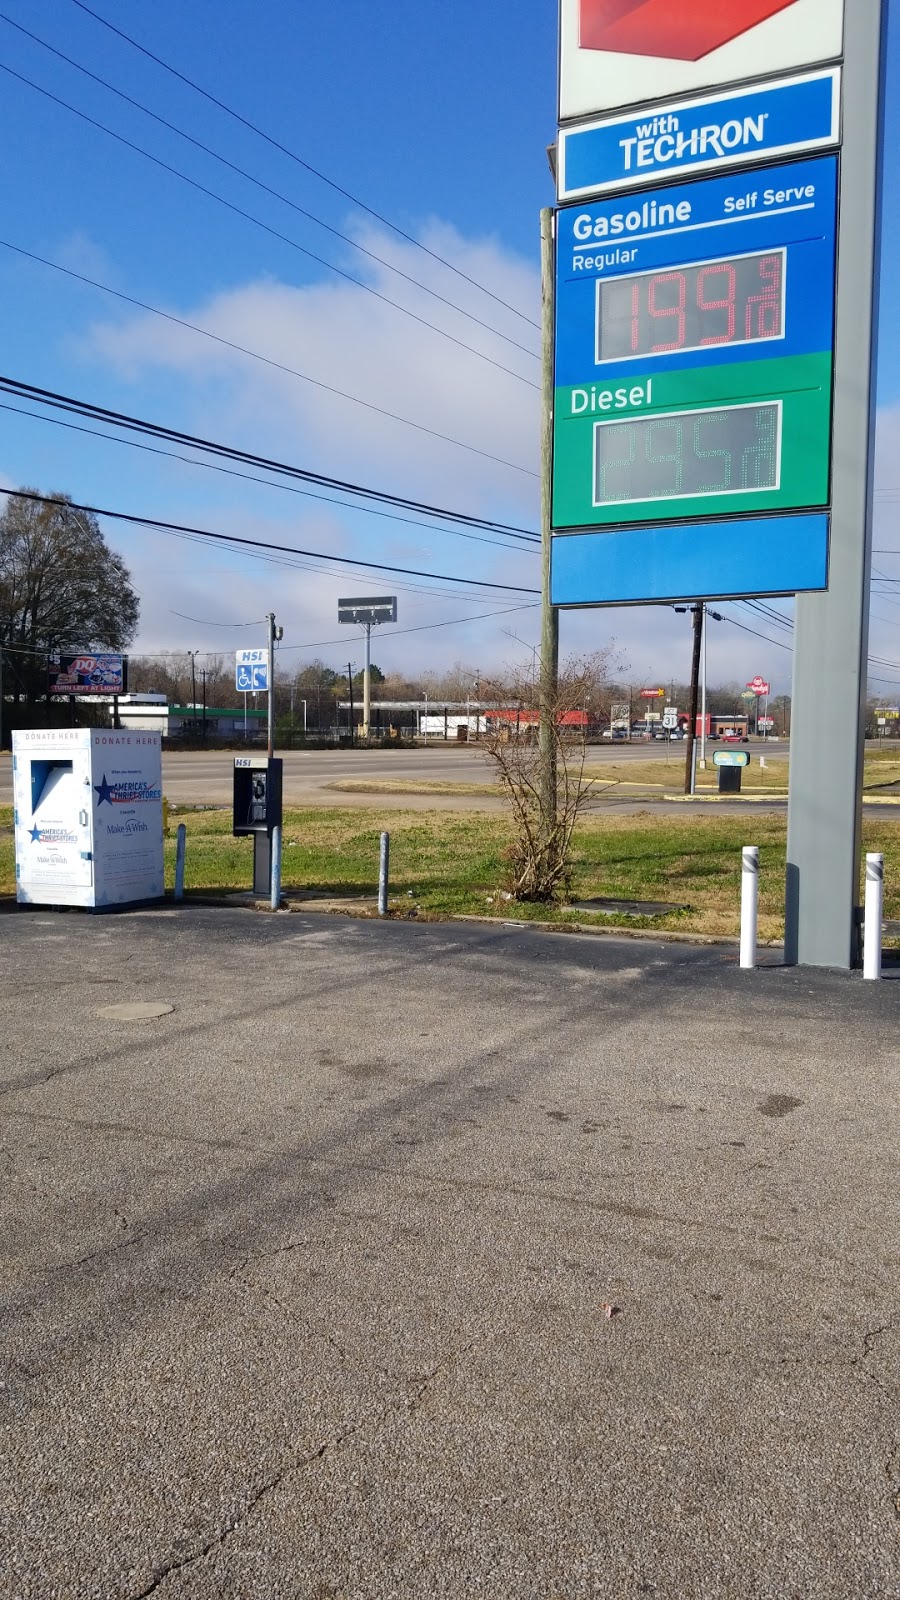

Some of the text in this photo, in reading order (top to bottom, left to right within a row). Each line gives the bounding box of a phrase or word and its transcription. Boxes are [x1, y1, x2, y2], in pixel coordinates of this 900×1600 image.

[636, 114, 679, 139] with
[573, 184, 815, 240] Gasoline Self Serve
[572, 247, 638, 271] Regular
[571, 379, 652, 414] Diesel
[242, 651, 263, 661] HSI
[75, 659, 95, 672] DQ
[665, 716, 674, 726] 31
[58, 732, 79, 740] HERE
[95, 737, 158, 745] DONATE HERE
[235, 759, 252, 767] HSI
[113, 782, 147, 792] AMERICA'S
